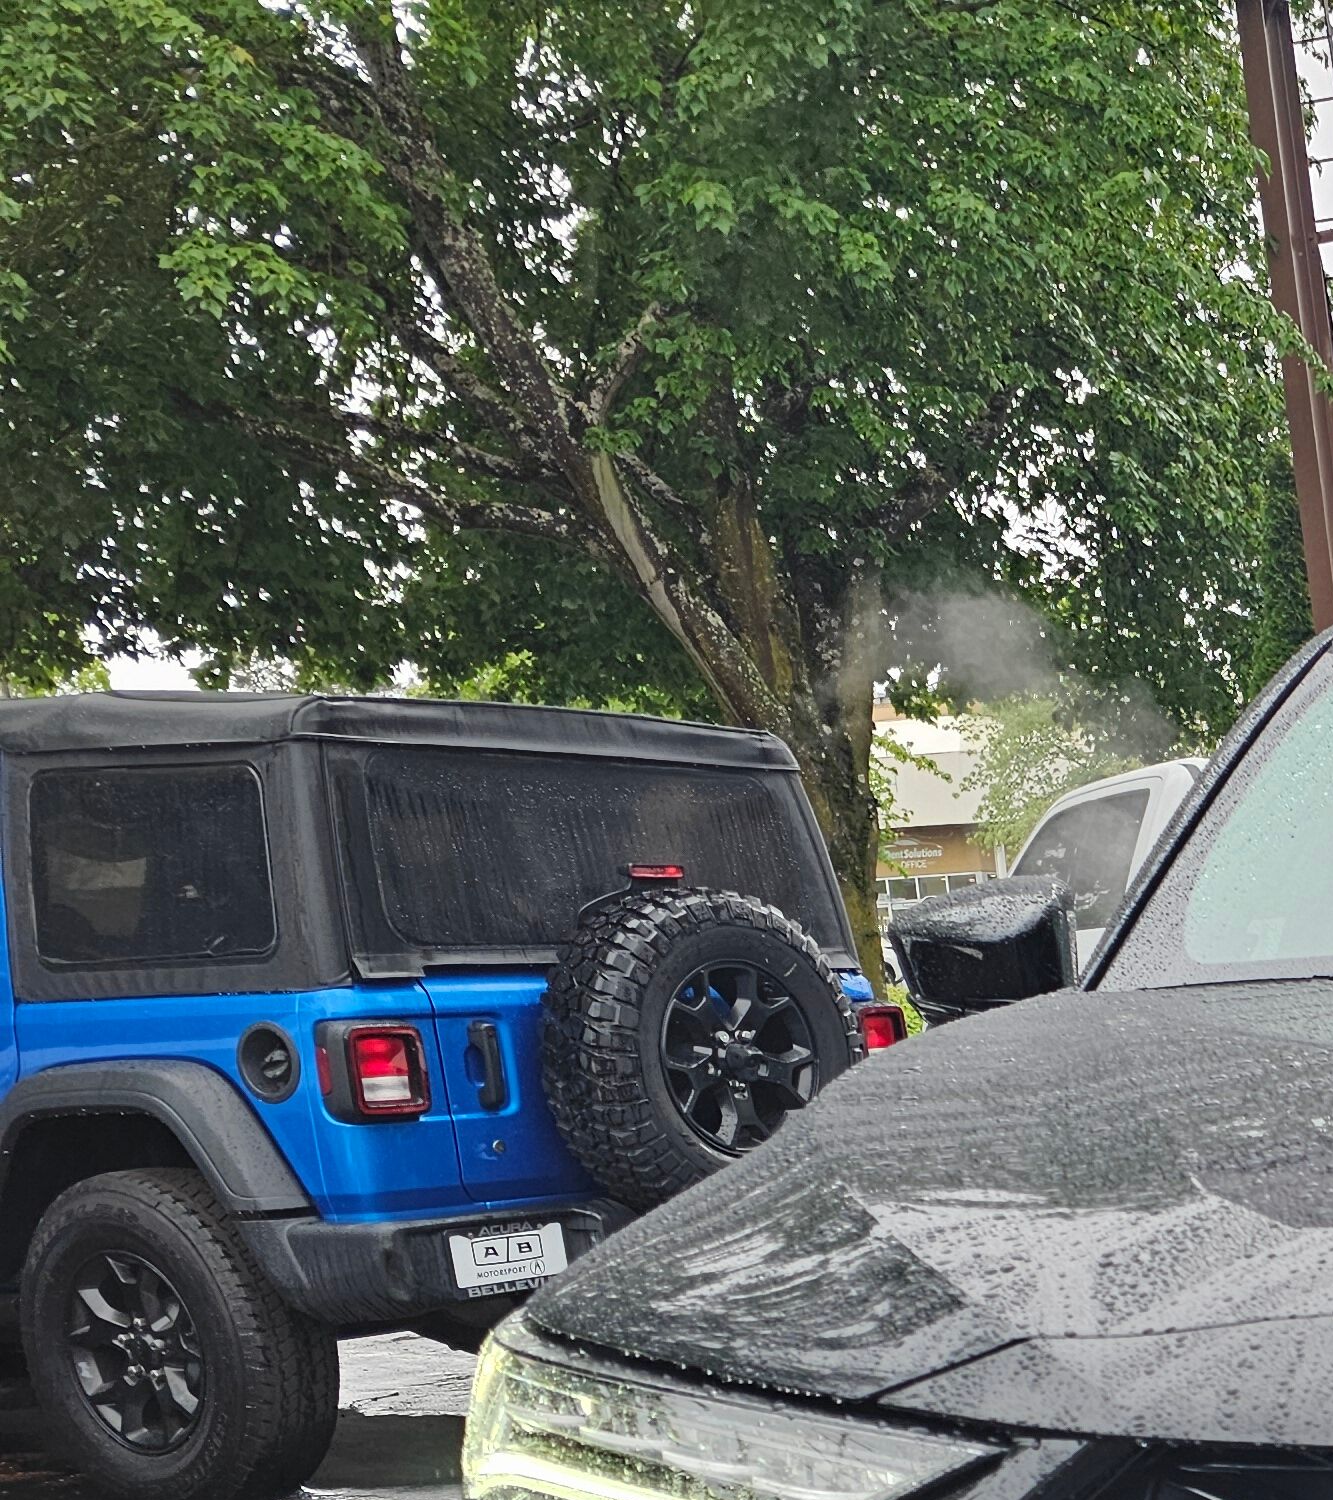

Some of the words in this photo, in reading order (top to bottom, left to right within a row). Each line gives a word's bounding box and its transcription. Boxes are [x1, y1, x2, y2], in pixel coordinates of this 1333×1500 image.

[478, 1221, 533, 1237] ACURA
[477, 1265, 527, 1280] MOTORSPORT
[467, 1276, 549, 1298] BELLEV
